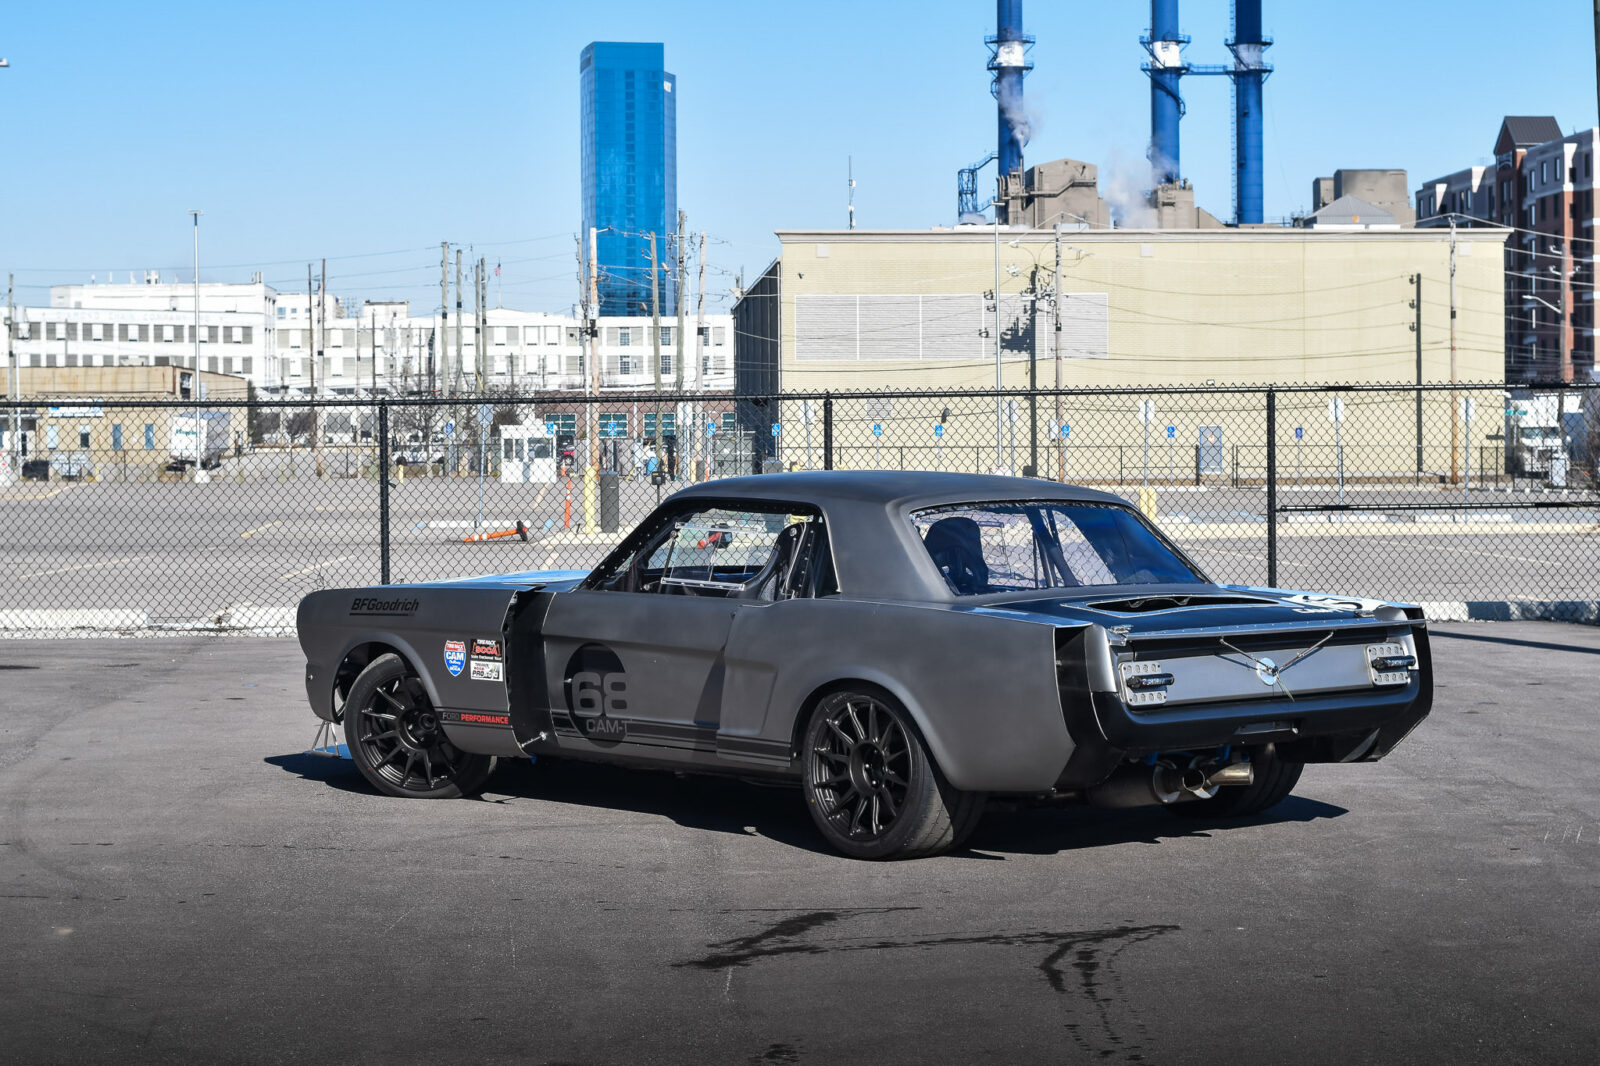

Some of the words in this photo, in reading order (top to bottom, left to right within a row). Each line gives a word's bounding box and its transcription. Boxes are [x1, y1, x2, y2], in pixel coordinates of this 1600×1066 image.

[351, 598, 419, 612] BFGoodrich
[446, 651, 464, 661] CAM
[475, 645, 498, 655] SCCA
[571, 671, 631, 718] 68
[442, 711, 460, 721] FORD
[461, 713, 509, 725] PERFORMANCE
